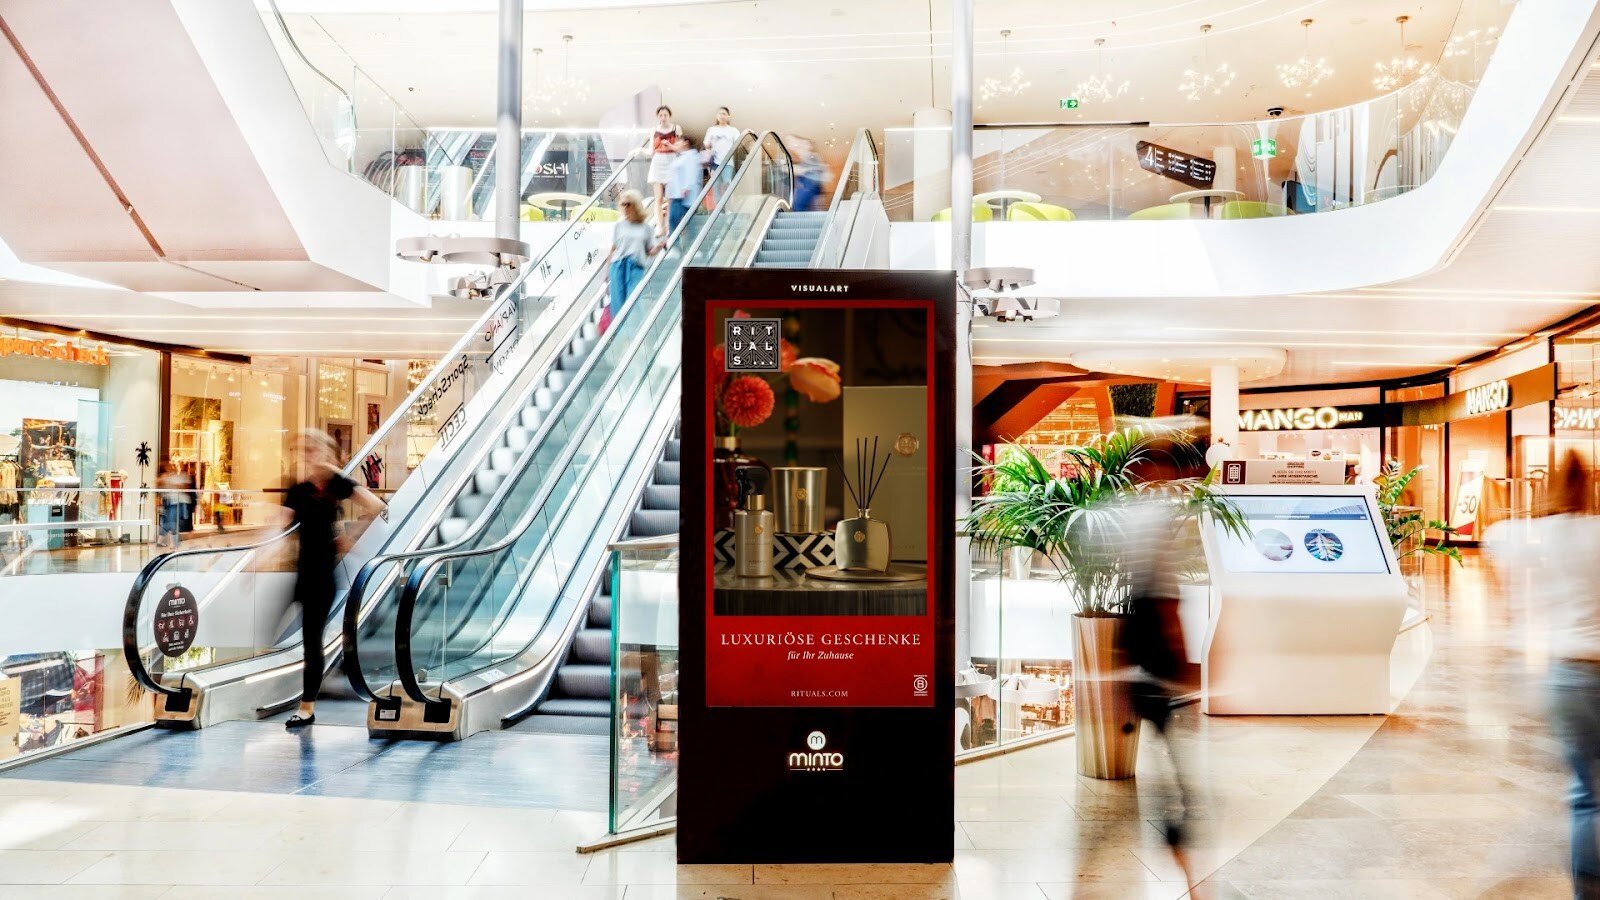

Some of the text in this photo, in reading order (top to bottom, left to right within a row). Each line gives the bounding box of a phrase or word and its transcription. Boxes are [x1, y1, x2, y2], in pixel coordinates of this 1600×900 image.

[1145, 146, 1155, 166] 4
[791, 284, 849, 292] VISUALART
[1466, 380, 1509, 415] MANGO
[1239, 407, 1363, 430] MANGO MAN
[721, 632, 921, 645] LUXURIÖSE GESCHENKE
[787, 651, 854, 660] für Ihr Zuhause
